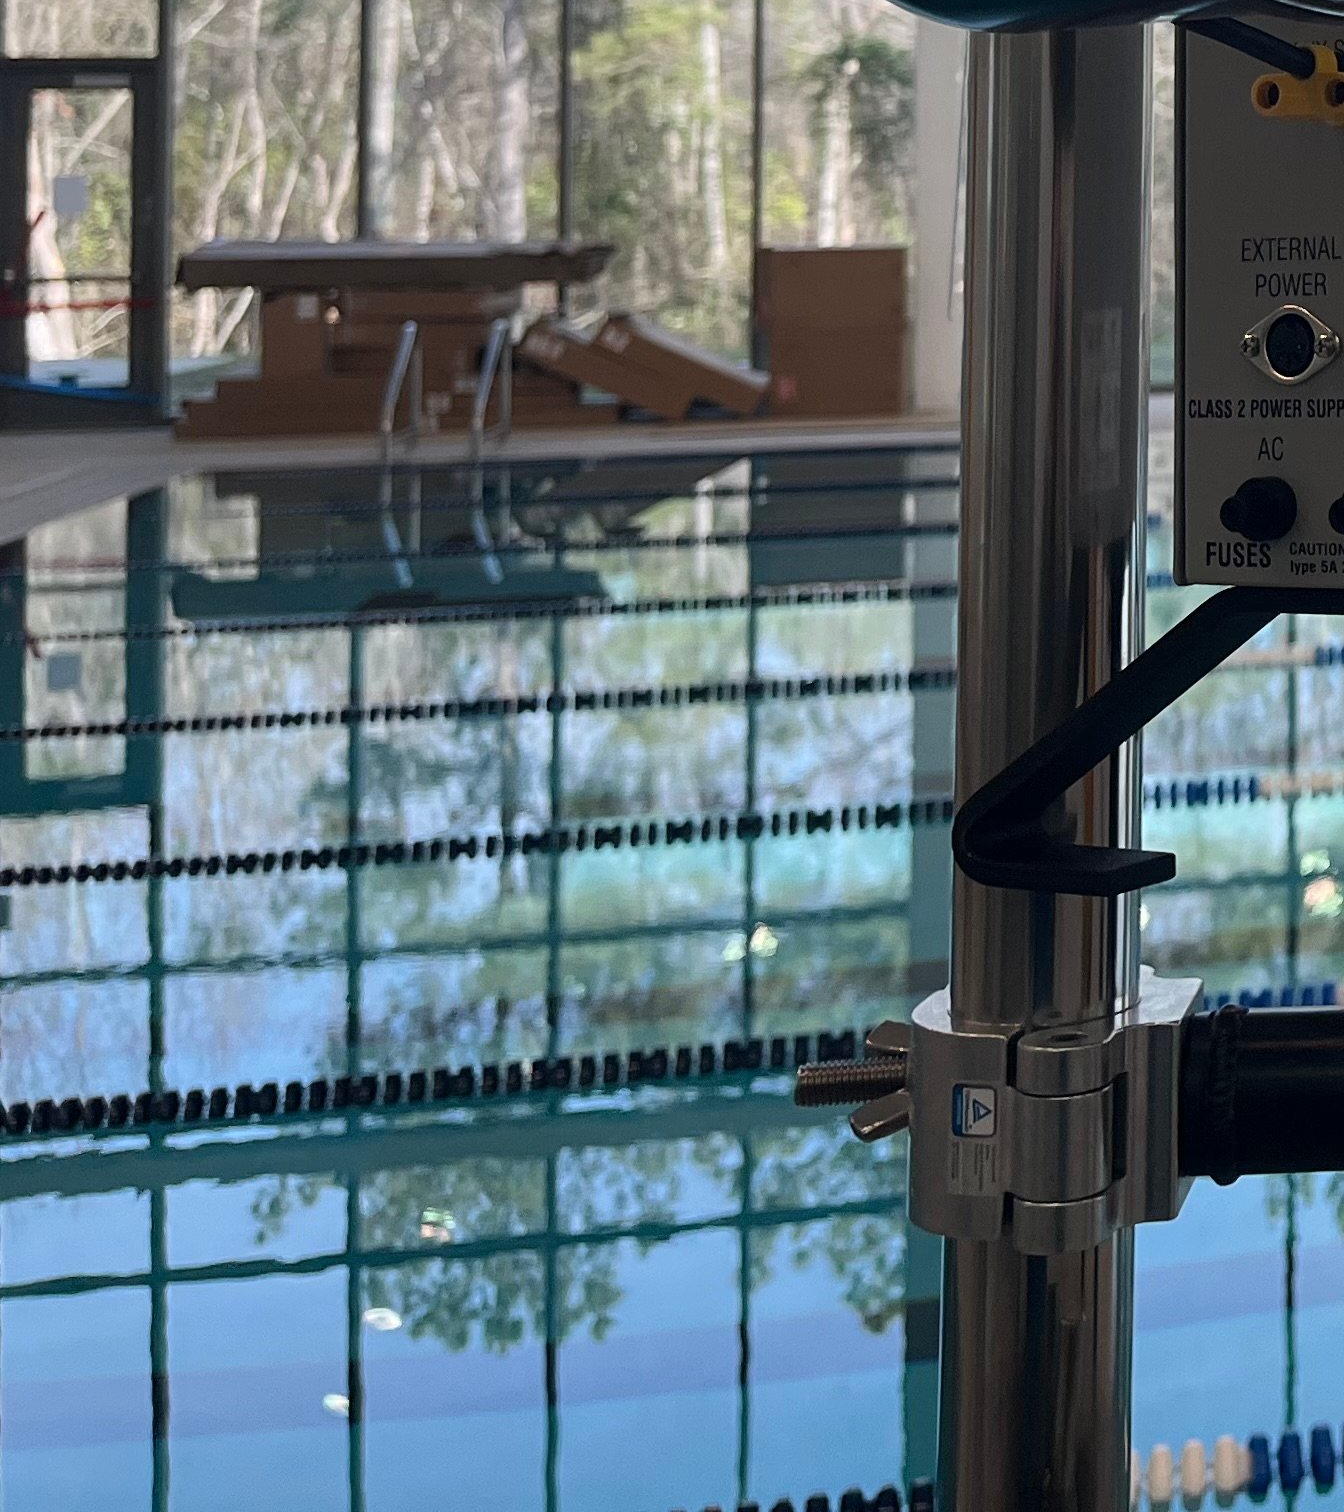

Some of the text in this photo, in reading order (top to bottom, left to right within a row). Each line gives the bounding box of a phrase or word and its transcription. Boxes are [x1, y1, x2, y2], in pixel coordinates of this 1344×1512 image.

[1241, 235, 1342, 263] EXTERNAL
[1255, 272, 1327, 298] POWER
[1188, 399, 1233, 419] CLASS
[1237, 399, 1246, 418] 2
[1250, 399, 1302, 418] POWER
[1257, 436, 1284, 461] AC
[1206, 541, 1272, 569] FUSES
[1321, 560, 1338, 574] 5A
